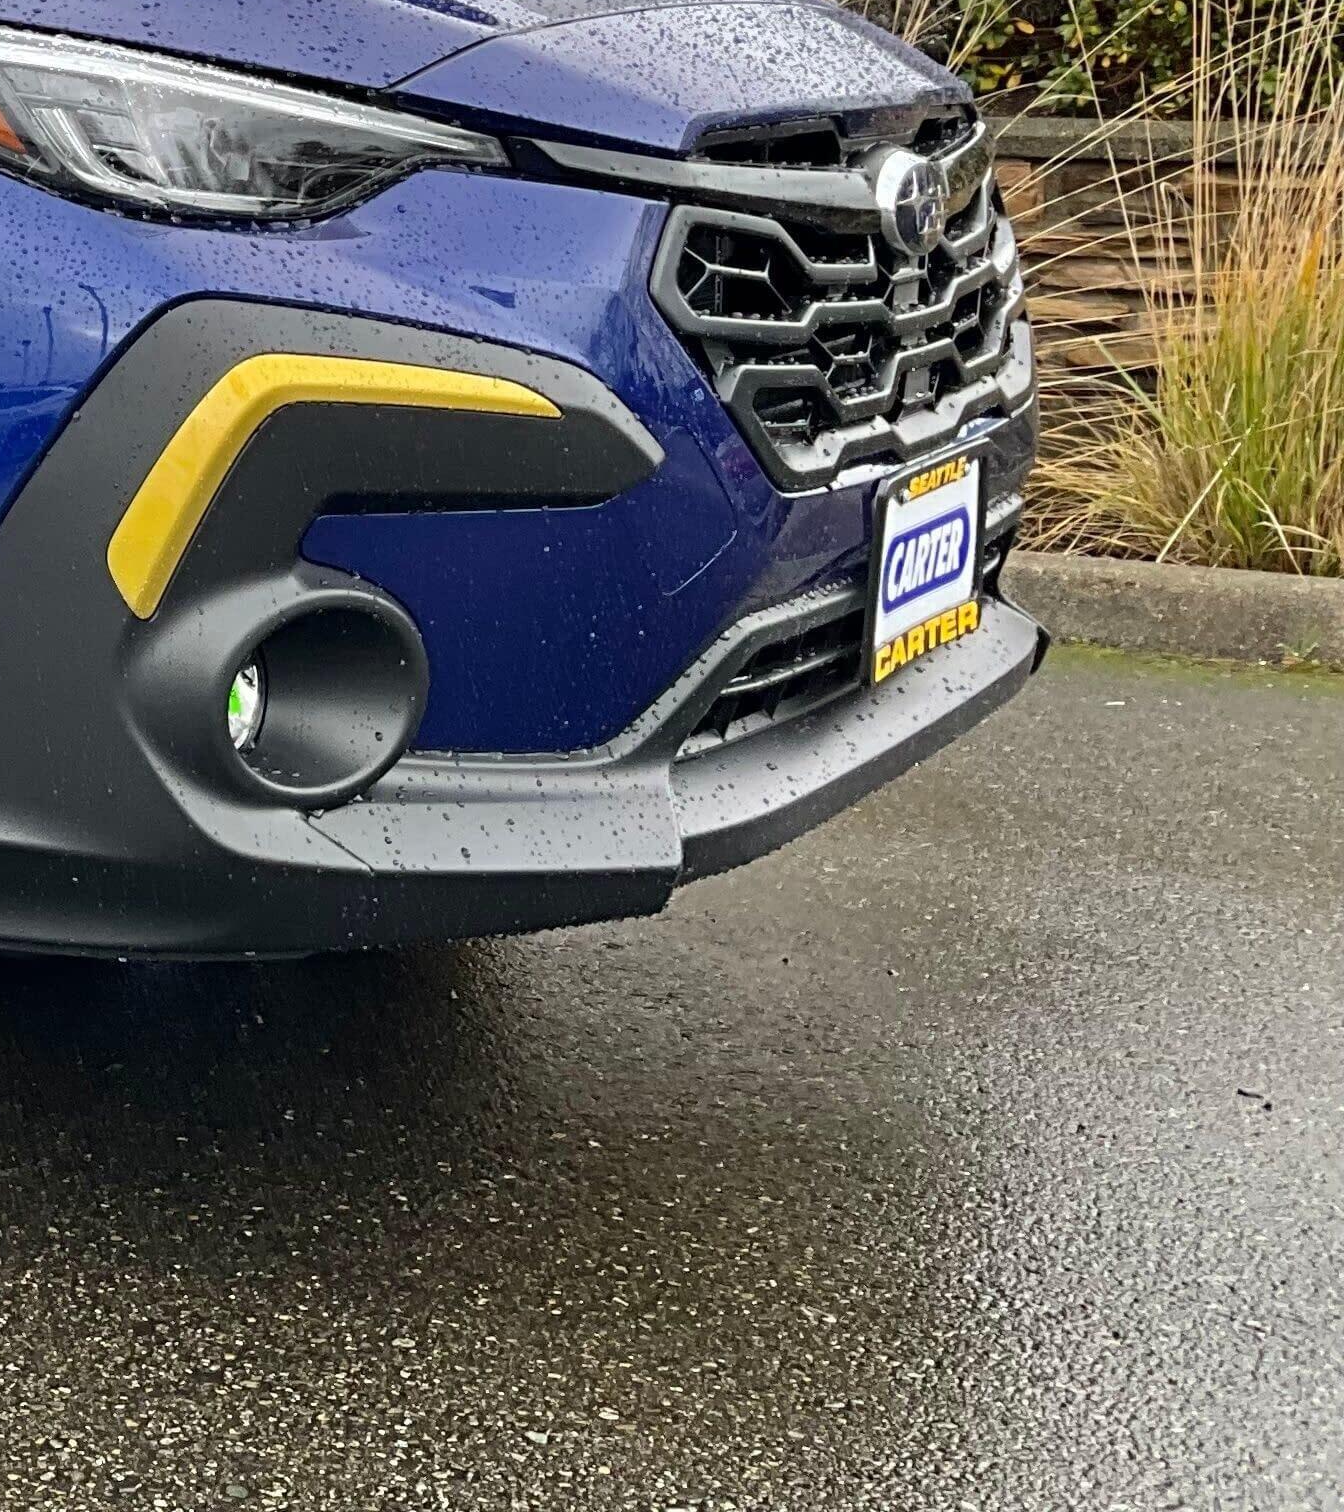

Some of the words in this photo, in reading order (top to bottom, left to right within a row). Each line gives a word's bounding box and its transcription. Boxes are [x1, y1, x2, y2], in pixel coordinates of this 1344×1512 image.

[907, 456, 967, 499] SEATTLE
[888, 518, 964, 601] CARTER
[874, 600, 980, 683] CARTER
